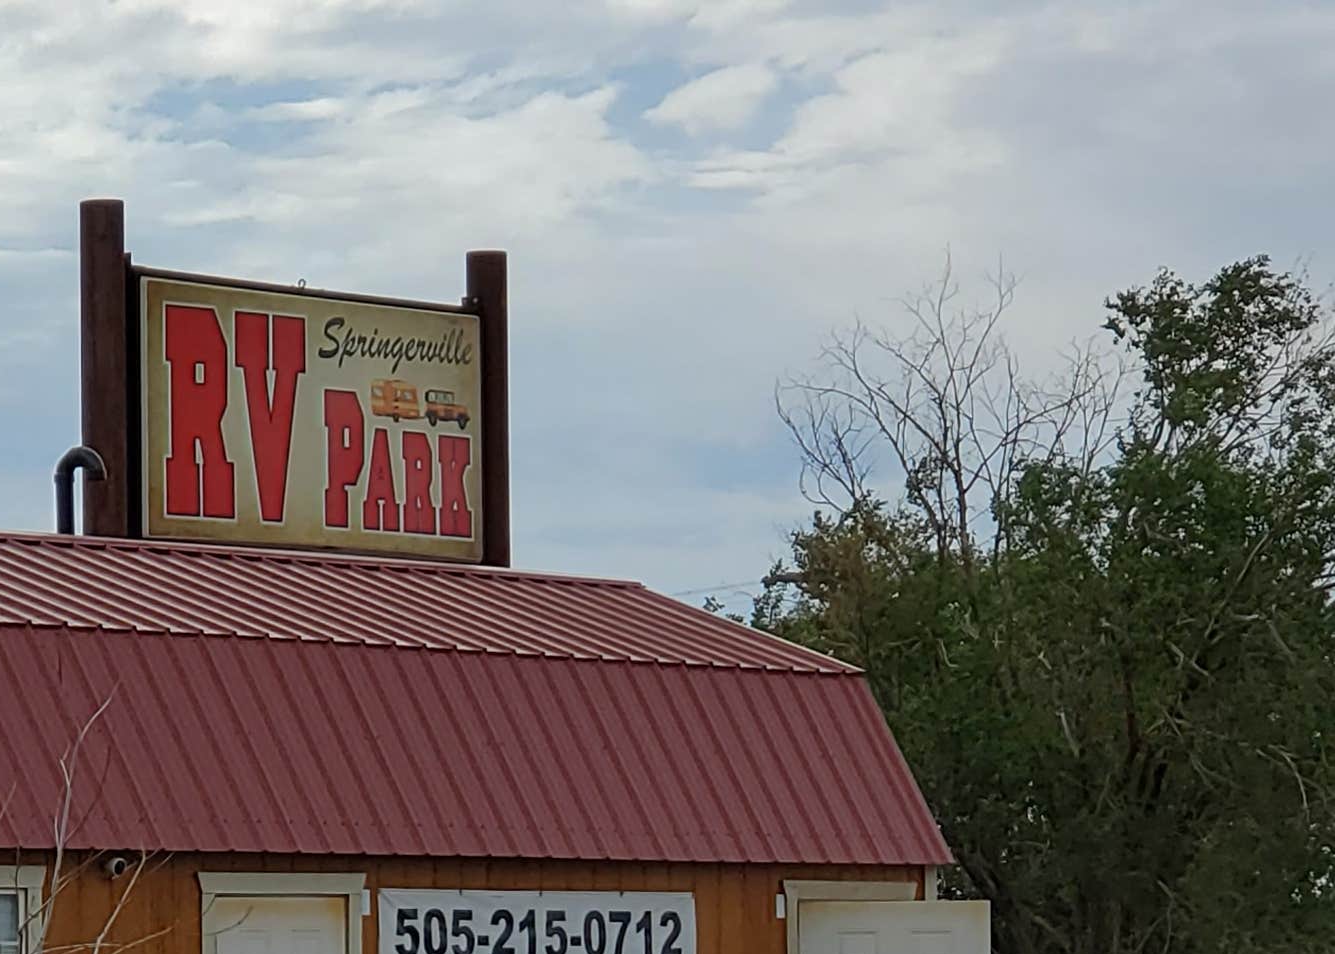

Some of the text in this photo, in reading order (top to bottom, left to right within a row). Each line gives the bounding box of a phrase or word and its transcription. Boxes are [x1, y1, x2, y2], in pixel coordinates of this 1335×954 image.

[164, 303, 306, 523] RV
[318, 317, 472, 374] Springerville
[324, 389, 472, 538] PARK
